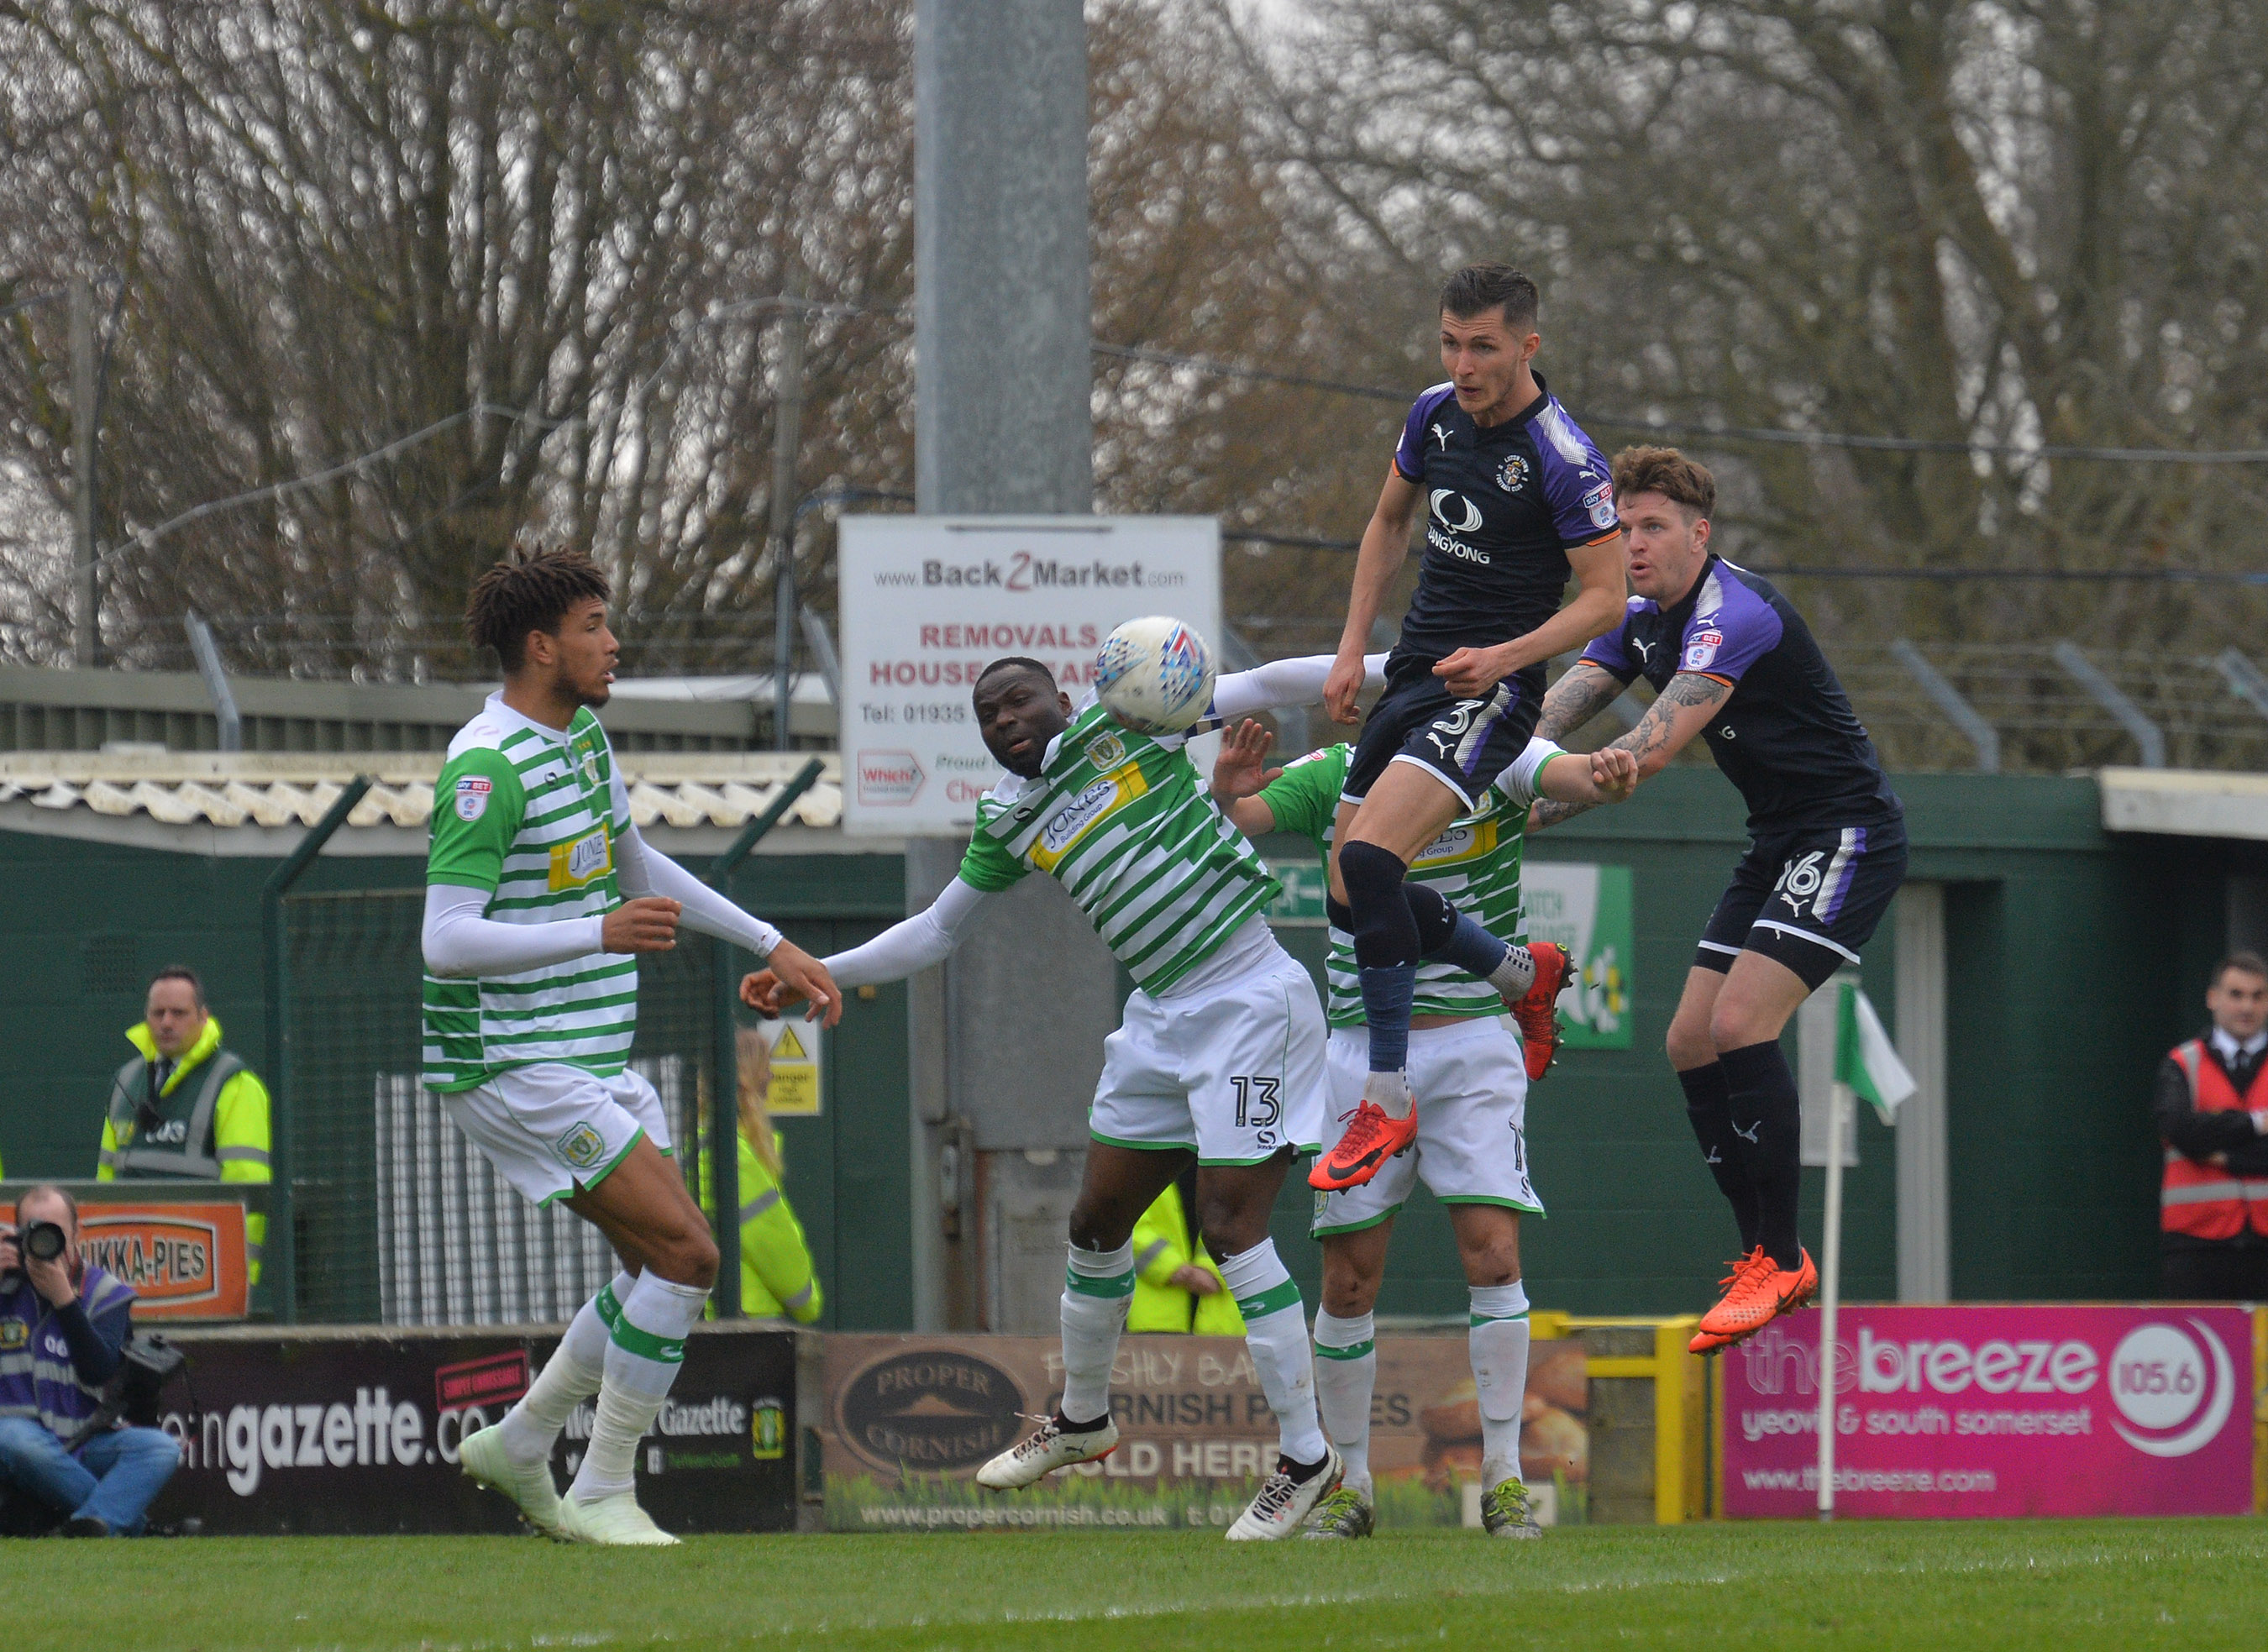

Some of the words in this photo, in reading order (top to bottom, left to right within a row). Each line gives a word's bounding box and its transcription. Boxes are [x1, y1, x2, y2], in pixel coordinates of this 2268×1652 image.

[1427, 522, 1490, 564] ANGYONG
[874, 550, 1184, 592] www.Back2Market.com
[920, 624, 1098, 649] REMOVALS
[1703, 634, 1721, 644] BET
[860, 703, 895, 724] Tel:
[902, 703, 965, 724] 01935
[1432, 699, 1485, 736] 3
[1050, 780, 1110, 849] JONES
[1060, 817, 1085, 844] Building
[1083, 803, 1104, 823] Group
[571, 833, 606, 872] JONE
[1426, 845, 1454, 856] Group
[1774, 850, 1825, 895] 16
[1230, 1076, 1280, 1128] 13
[1509, 1120, 1523, 1172] 1
[80, 1236, 207, 1287] UKKA-PIES
[878, 1364, 991, 1398] PROPER
[2118, 1361, 2196, 1396] 105.6
[659, 1394, 747, 1436] Gazette
[1045, 1391, 1232, 1425] CRNISH
[1836, 1403, 1862, 1435] &
[1865, 1407, 1950, 1435] south
[1953, 1403, 2092, 1435] somerset
[866, 1423, 1002, 1462] CORNISH
[1172, 1440, 1279, 1478] HERE
[859, 1505, 1168, 1529] www.propercornish.co.uk
